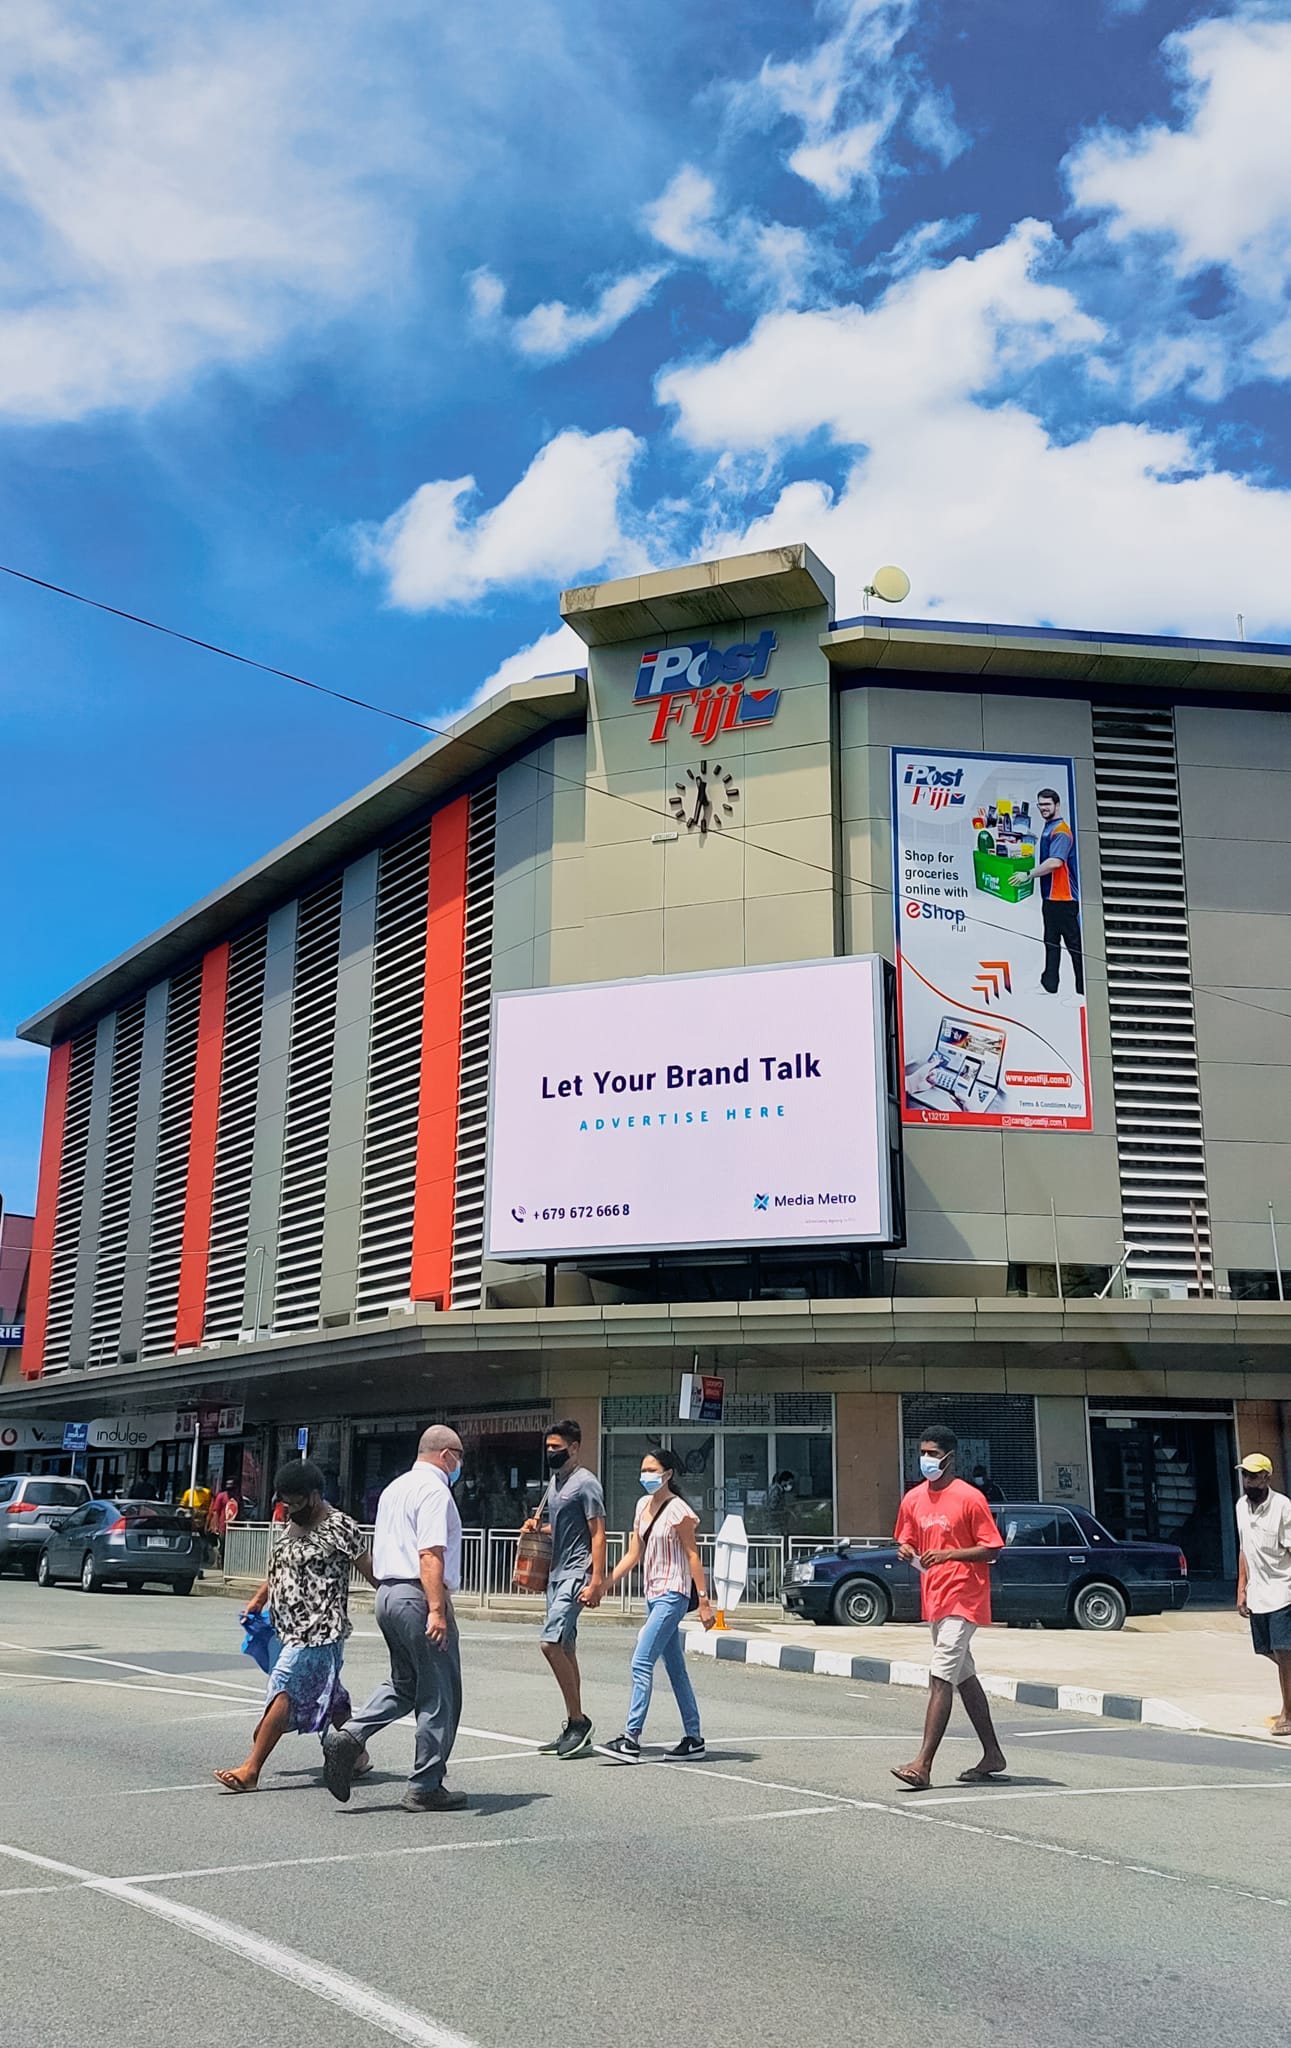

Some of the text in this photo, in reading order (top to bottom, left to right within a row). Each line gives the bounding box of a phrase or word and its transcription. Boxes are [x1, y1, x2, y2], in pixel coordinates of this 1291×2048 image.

[645, 683, 746, 744] Fiji
[912, 786, 951, 810] Fiji
[904, 850, 954, 865] Shop for
[904, 868, 959, 881] groceries
[904, 884, 968, 898] online with
[906, 901, 966, 924] eShop
[951, 924, 967, 933] FIJI
[541, 1052, 822, 1099] Let Your Brand Talk
[1005, 1074, 1072, 1087] www.postfiji.com.fj
[579, 1105, 786, 1131] ADVERTISE HERE
[774, 1192, 857, 1207] Media Metro
[570, 1205, 593, 1219] 672
[96, 1421, 148, 1445] indulge
